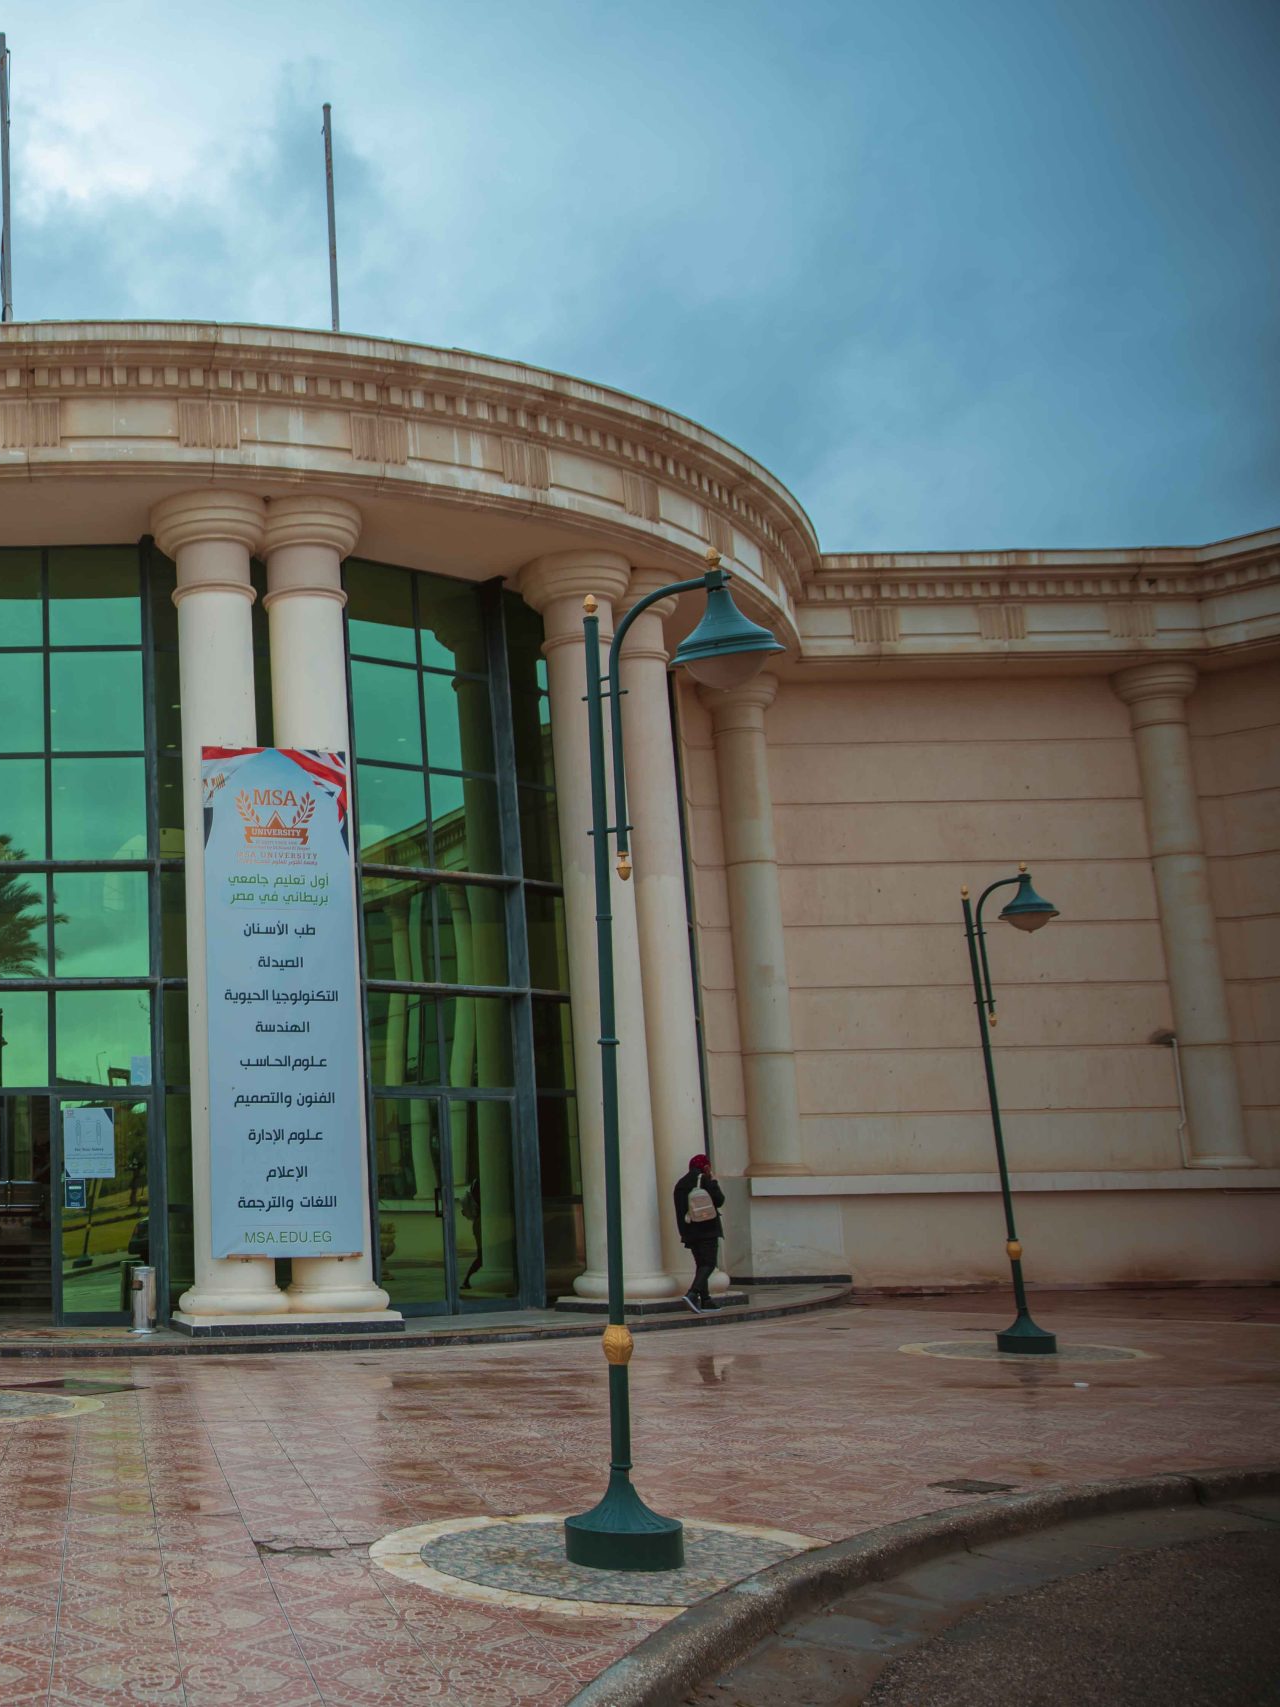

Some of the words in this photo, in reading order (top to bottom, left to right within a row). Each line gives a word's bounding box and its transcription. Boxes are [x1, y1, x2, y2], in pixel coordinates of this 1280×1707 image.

[253, 788, 298, 806] MSA
[251, 828, 301, 837] UNIVERSITY
[228, 874, 269, 887] جامعي
[274, 874, 306, 888] تعليم
[310, 873, 329, 890] أول
[230, 894, 255, 904] مصر
[259, 893, 279, 904] في
[282, 892, 328, 906] بريطاني
[244, 920, 288, 937] الأسنان
[294, 924, 316, 938] طب
[258, 956, 304, 971] الصيدلة
[224, 989, 269, 1004] الحيوية
[272, 990, 338, 1006] التكنولوجيا
[255, 1021, 310, 1033] الهندسة
[240, 1055, 290, 1070] الحاسب
[292, 1056, 328, 1071] علوم
[234, 1092, 292, 1108] والتصميم
[296, 1092, 336, 1108] الفنون
[248, 1128, 284, 1144] الإدارة
[288, 1129, 324, 1144] علوم
[266, 1166, 308, 1182] الإعلام
[238, 1196, 294, 1212] والترجمة
[300, 1196, 337, 1208] اللغات
[244, 1230, 332, 1244] MSA.EDU.EG
